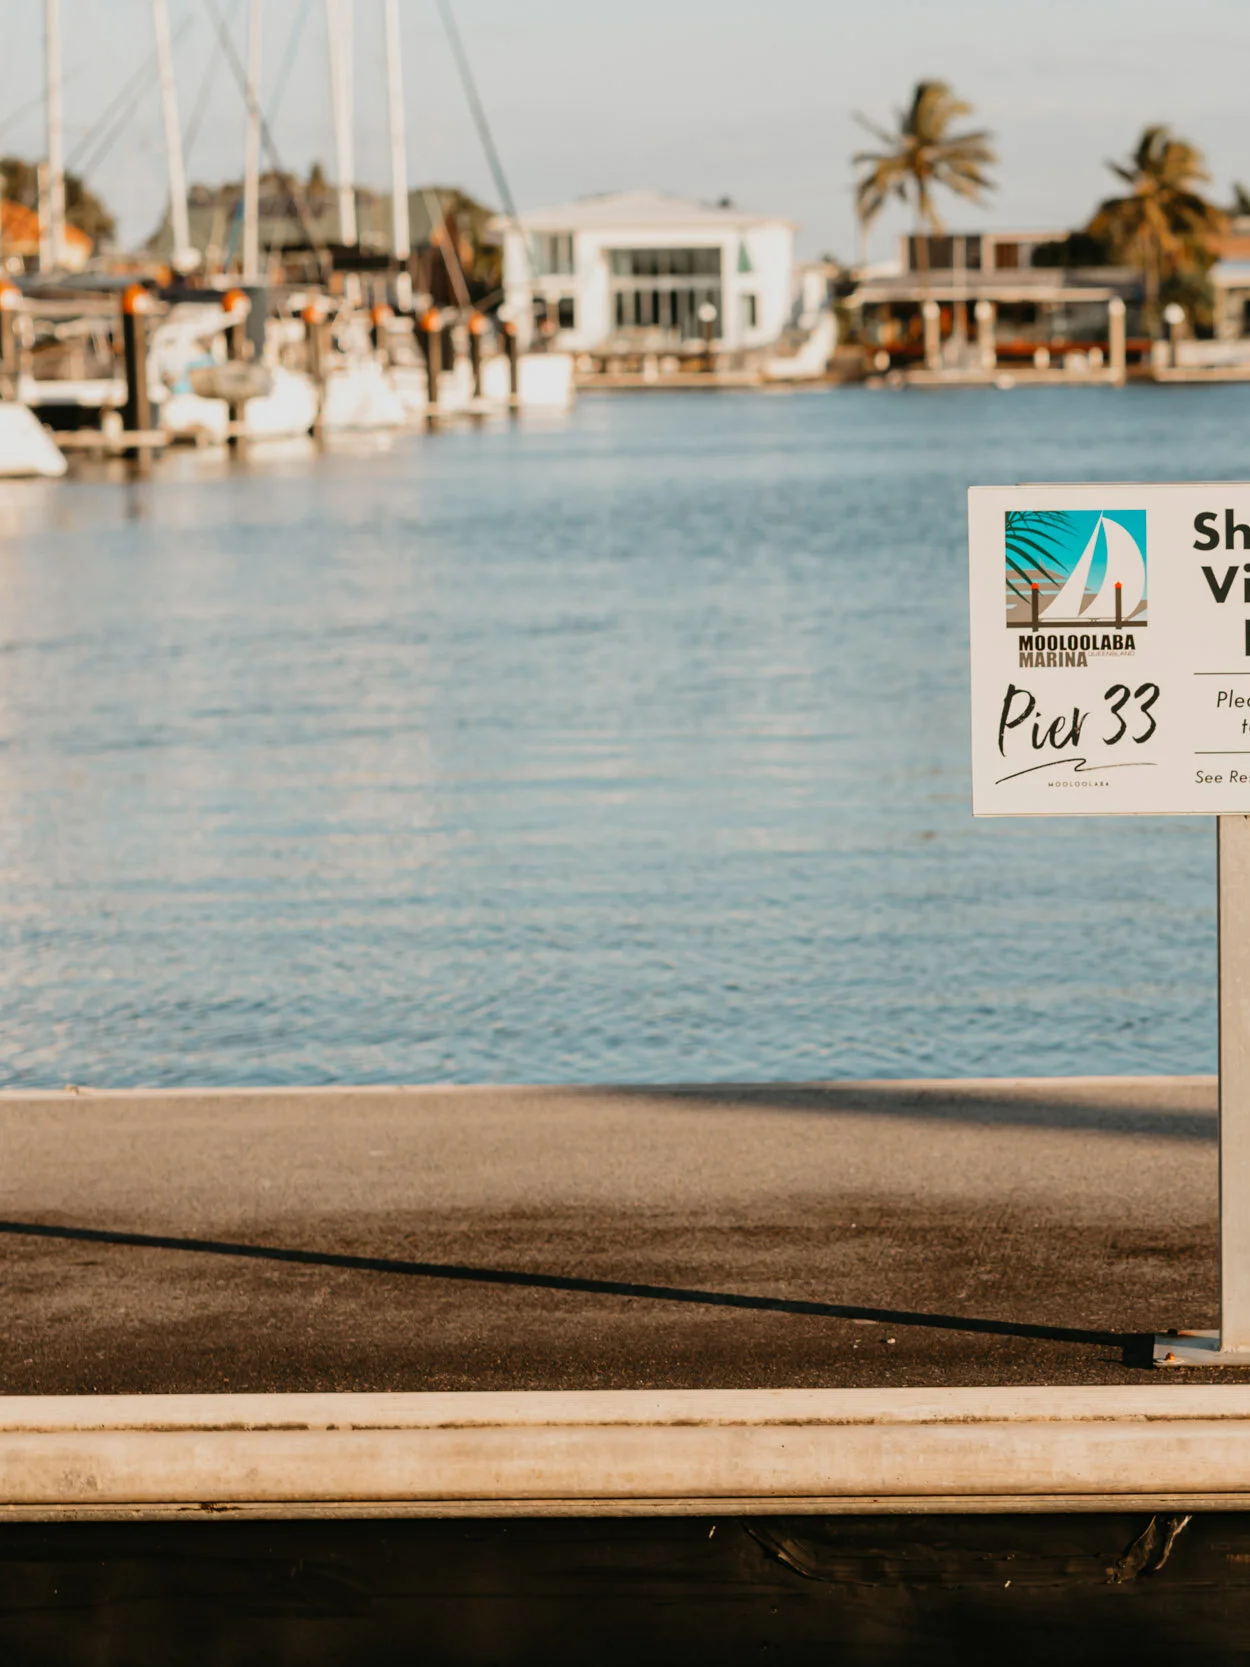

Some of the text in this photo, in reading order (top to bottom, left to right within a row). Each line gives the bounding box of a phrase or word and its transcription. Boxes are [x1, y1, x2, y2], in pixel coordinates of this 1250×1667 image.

[1019, 635, 1136, 651] MOOLOOLABA
[1019, 652, 1088, 668] MARINA
[998, 682, 1160, 757] Pier 33
[1195, 770, 1223, 784] See
